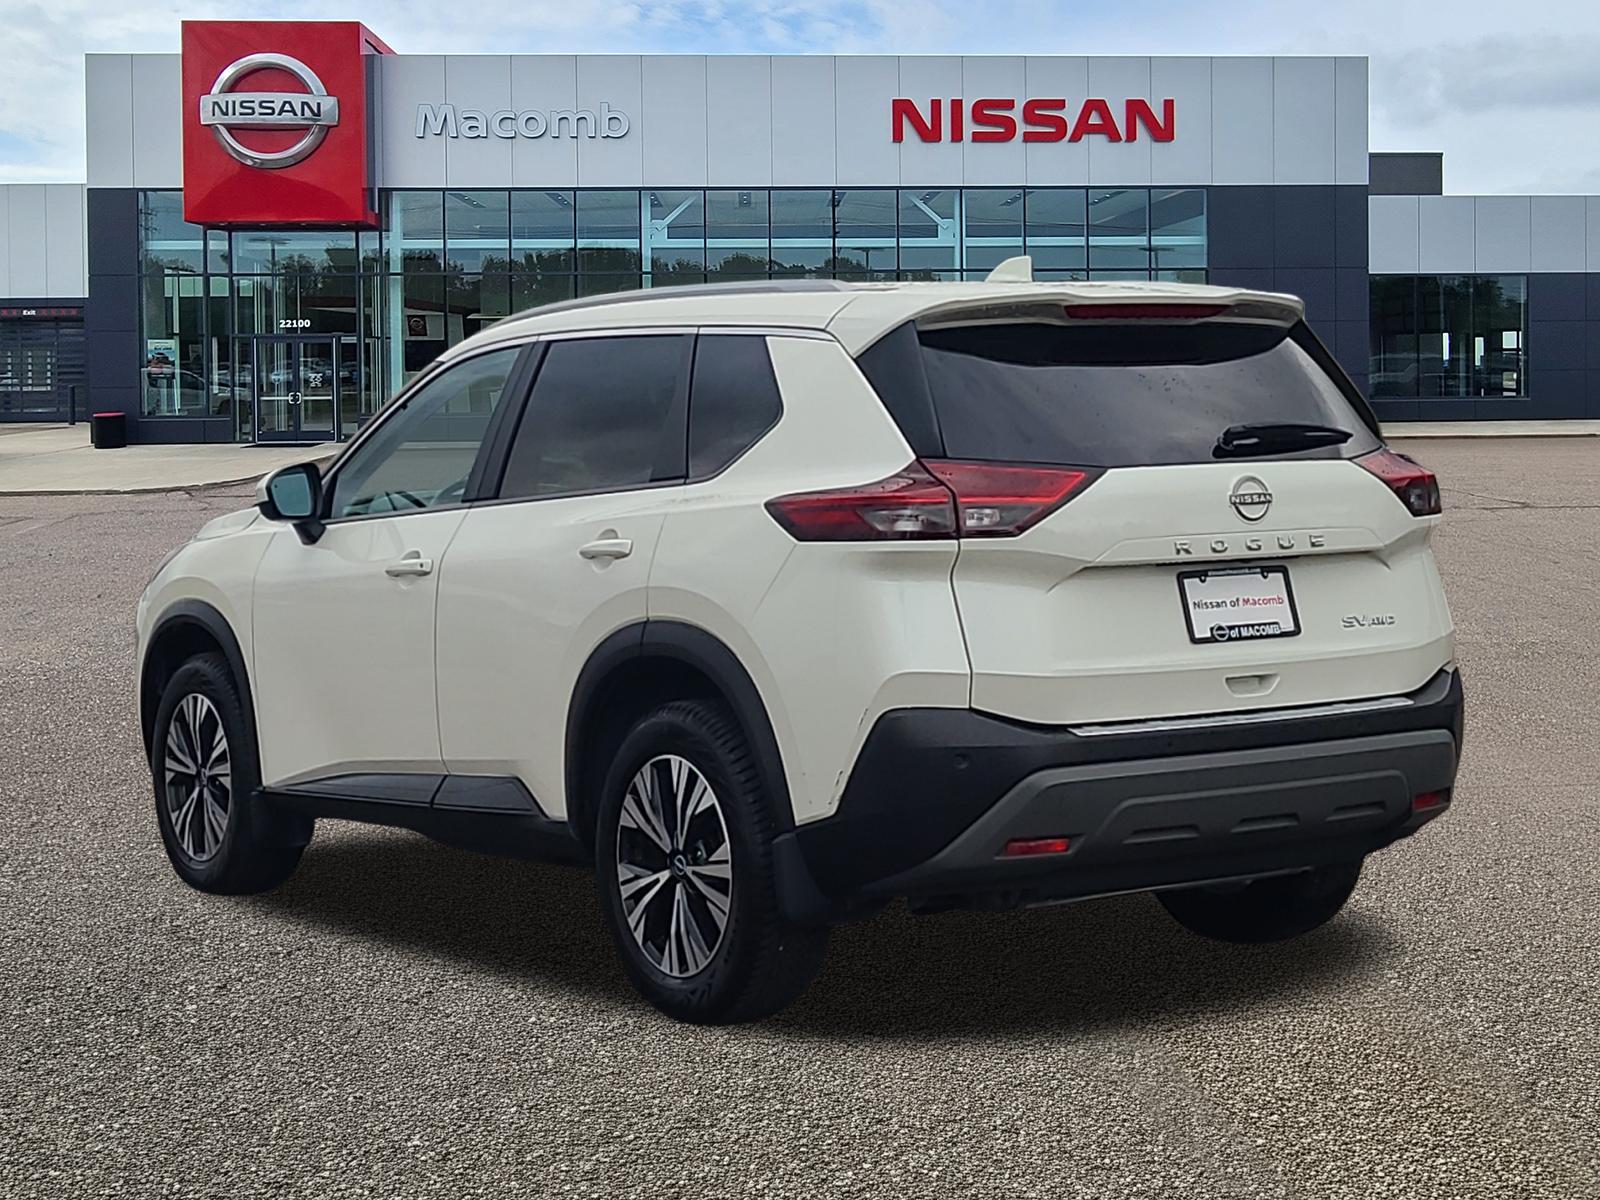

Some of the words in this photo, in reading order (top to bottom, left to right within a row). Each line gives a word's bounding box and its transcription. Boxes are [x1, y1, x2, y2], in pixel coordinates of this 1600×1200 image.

[211, 99, 323, 119] NISSAN
[415, 102, 630, 139] Macomb
[892, 98, 1175, 143] NISSAN
[279, 319, 311, 329] 22100
[1231, 493, 1273, 504] NISSAN
[1174, 534, 1326, 555] ROGUE
[1193, 598, 1228, 611] Nissan
[1229, 597, 1241, 608] of
[1242, 595, 1284, 607] Macomb
[1341, 615, 1367, 628] SV
[1230, 628, 1239, 639] of
[1240, 624, 1281, 637] MACOMB
